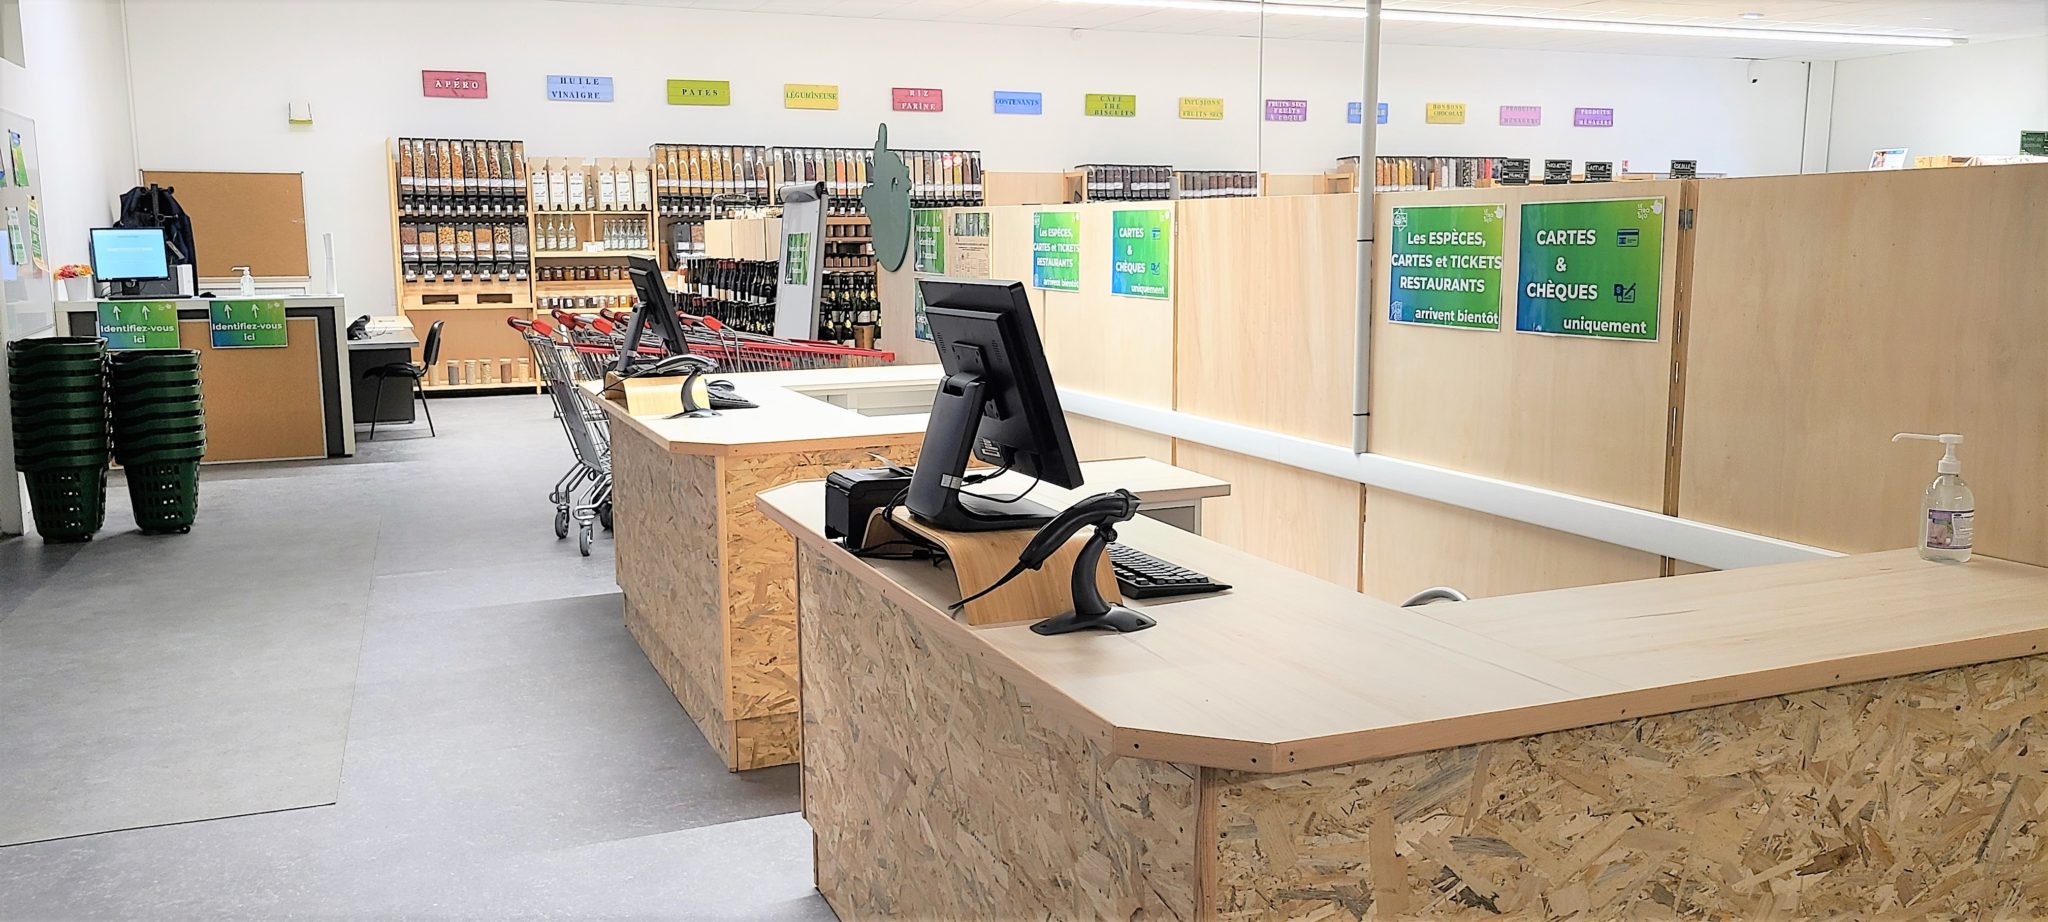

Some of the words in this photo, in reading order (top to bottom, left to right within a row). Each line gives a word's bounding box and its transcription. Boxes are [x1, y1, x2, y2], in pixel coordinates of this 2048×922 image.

[435, 77, 479, 89] APÉRO
[560, 77, 599, 86] HUILE
[551, 90, 600, 99] VINAIGRE
[682, 88, 718, 96] PATES
[909, 89, 929, 97] RIZ
[901, 102, 936, 111] FARINE
[995, 98, 1039, 106] CONTENANTS
[1094, 109, 1135, 117] BISCUITS
[1039, 227, 1047, 237] Les
[1048, 227, 1074, 239] ESPÈCES,
[1119, 227, 1145, 239] CARTES
[1407, 231, 1427, 245] Les
[1428, 228, 1487, 247] ESPÈCES,
[1536, 229, 1597, 246] CARTES
[1033, 242, 1051, 251] CARTES
[1051, 243, 1057, 252] et
[1057, 243, 1080, 252] TICKETS
[1126, 245, 1133, 256] &
[1037, 257, 1074, 268] RESTAURANTS
[1391, 253, 1433, 268] CARTES
[1435, 255, 1448, 268] et
[1450, 255, 1502, 270] TICKETS
[1555, 256, 1567, 273] &
[1115, 259, 1147, 276] CHÈQUES
[1043, 278, 1061, 287] arrivent
[1400, 277, 1485, 293] RESTAURANTS
[1131, 285, 1166, 296] uniquement
[1526, 280, 1598, 302] CHÈQUES
[1415, 309, 1456, 321] arrivent
[1457, 308, 1500, 325] bientôt
[100, 323, 175, 334] Identifiez-vous
[212, 322, 283, 333] Identifiez-vous
[1563, 316, 1648, 335] uniquement
[133, 334, 146, 344] ici
[243, 332, 256, 342] ici
